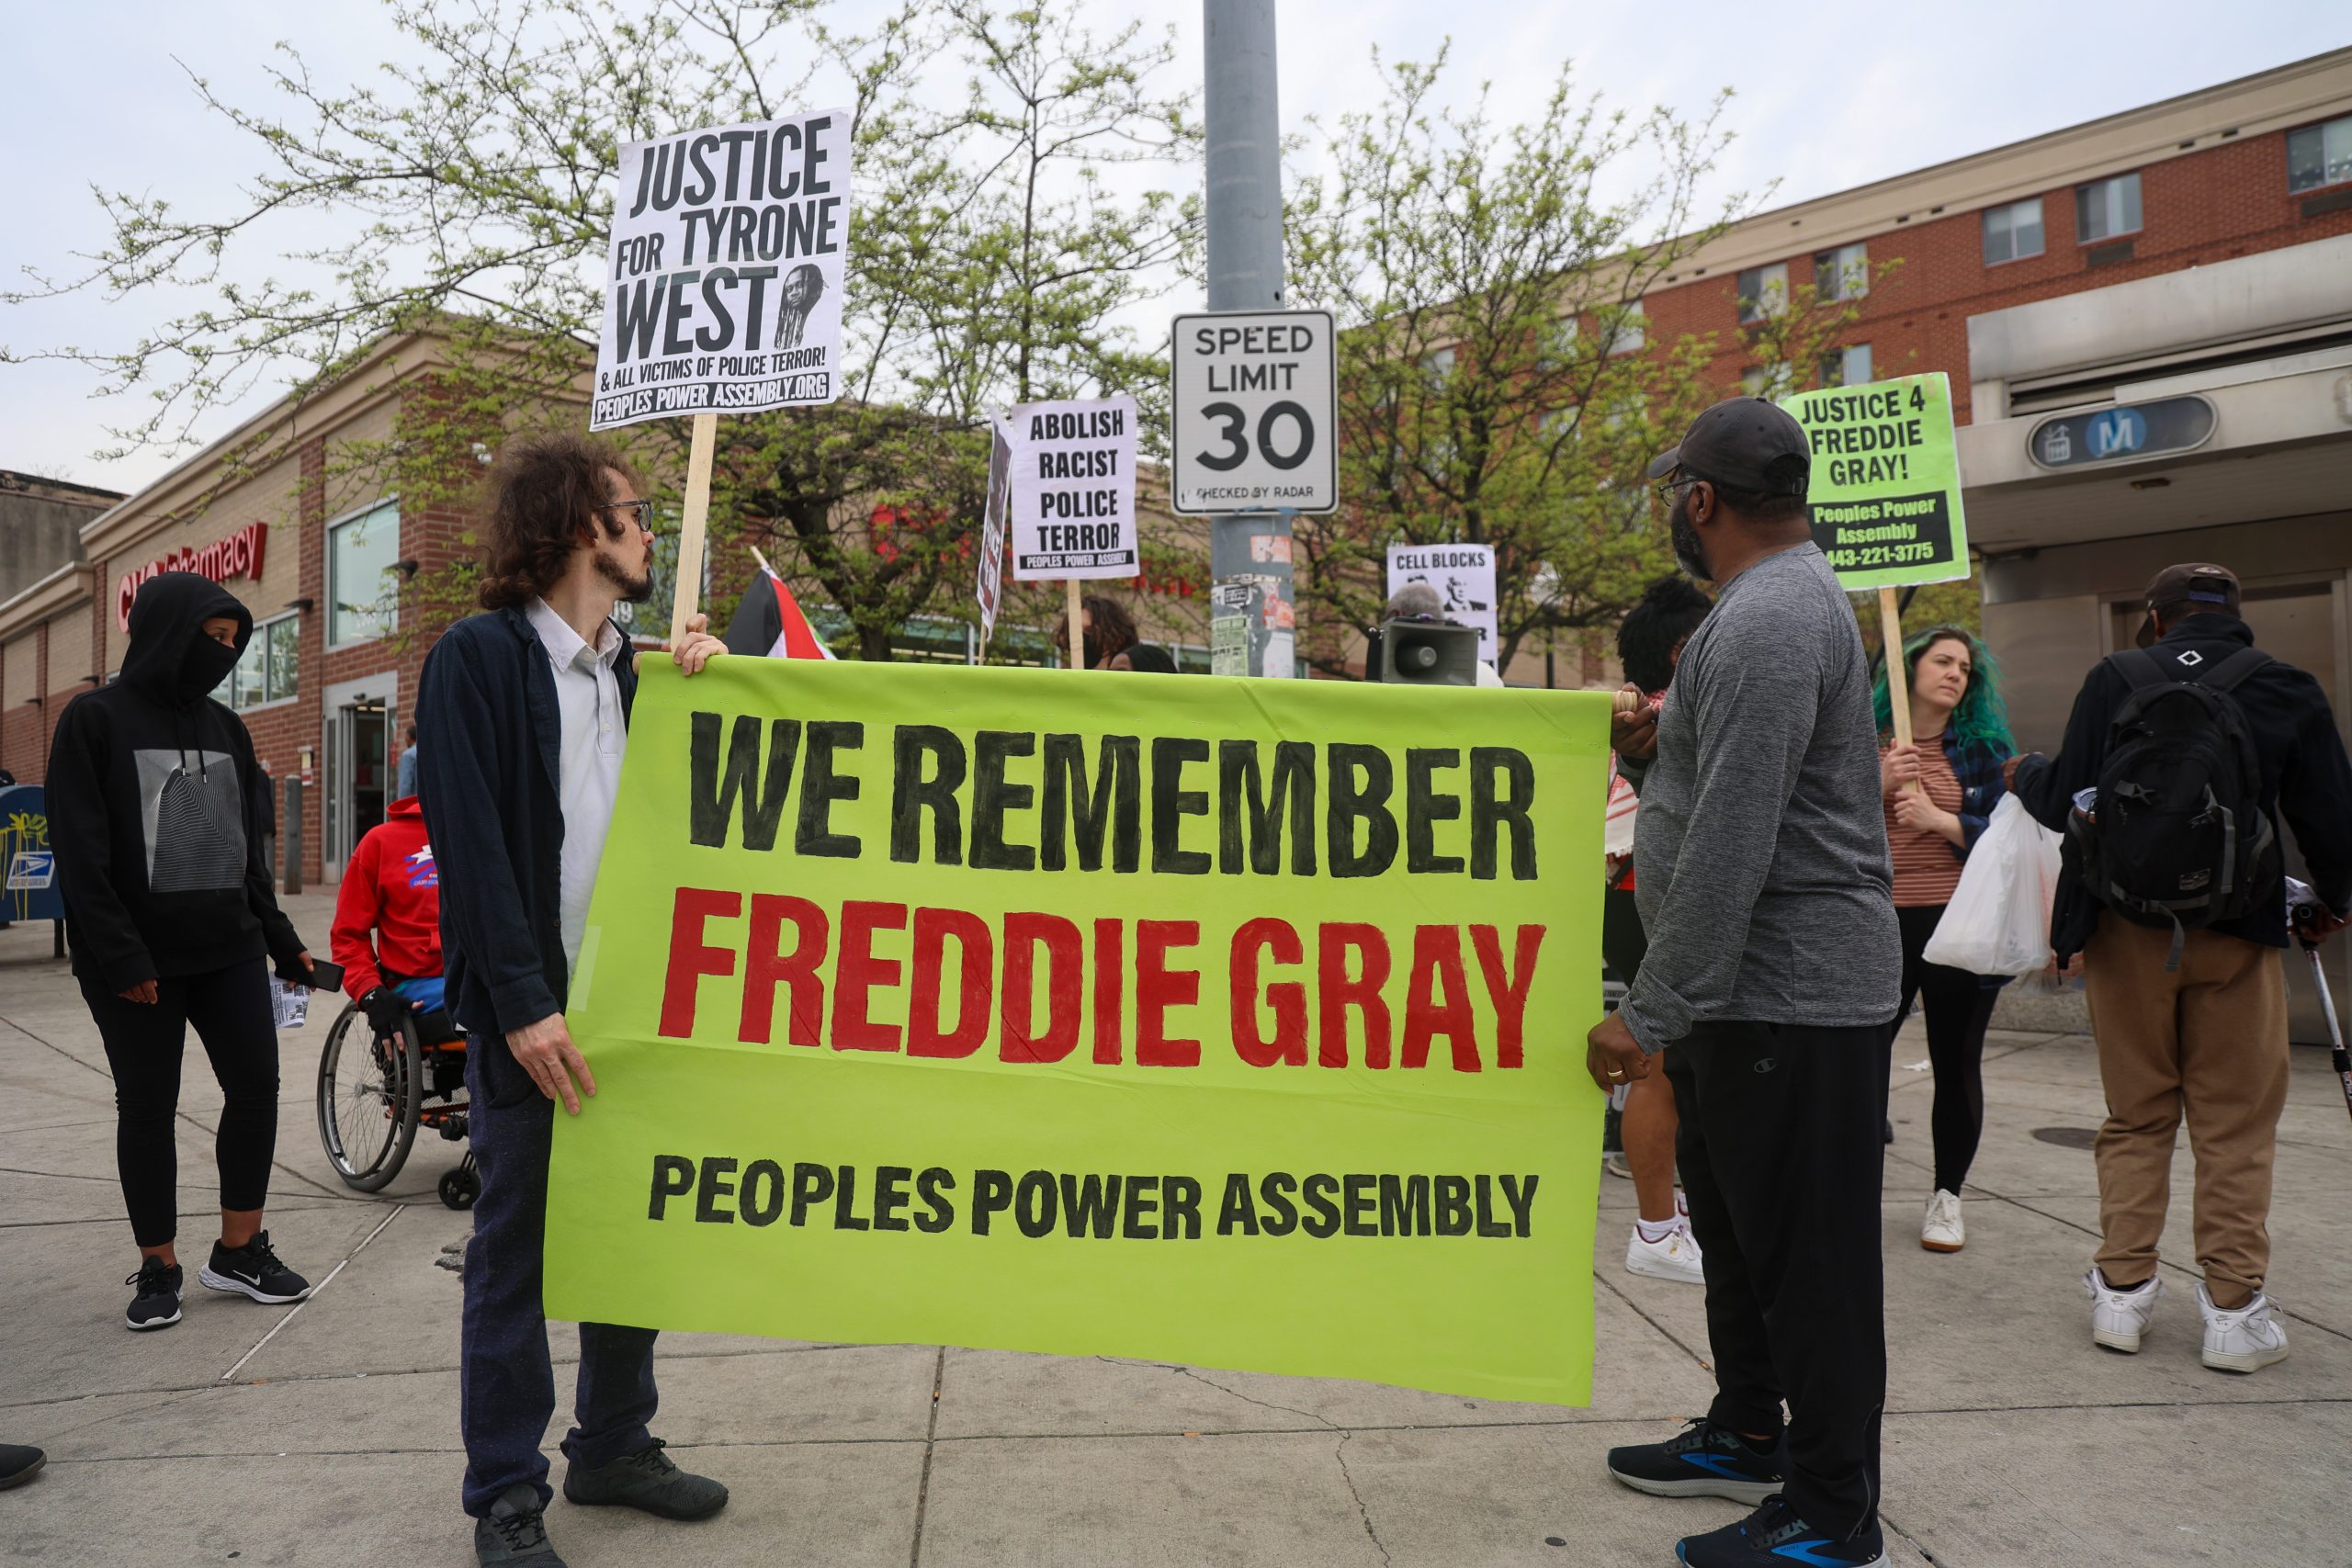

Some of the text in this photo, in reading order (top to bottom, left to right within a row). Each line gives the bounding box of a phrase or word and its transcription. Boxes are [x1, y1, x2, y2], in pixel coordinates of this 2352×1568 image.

[630, 116, 831, 219] JUSTICE
[616, 197, 841, 281] FOR TYRONE
[616, 265, 778, 364] WEST
[1194, 325, 1314, 355] SPEED
[600, 346, 827, 392] & ALL VICTIMS OF POLICE TERROR!
[1208, 363, 1299, 392] LIMIT
[596, 374, 827, 422] PEOPLES POWER ASSEMBLY.ORG
[1802, 384, 1925, 424] JUSTICE 4
[1030, 410, 1124, 441] ABOLISH
[1195, 400, 1315, 472] 30
[1811, 419, 1923, 455] FREDDIE
[1039, 449, 1118, 479] RACIST
[1830, 454, 1909, 486] GRAY!
[1041, 490, 1117, 518] POLICE
[1251, 487, 1269, 498] BY
[1274, 486, 1314, 498] RADAR
[1814, 498, 1937, 524] Peoples Power
[1037, 523, 1120, 552] TERROR
[1837, 523, 1917, 545] Assembly
[1027, 556, 1062, 568] PEOPLES
[1066, 554, 1094, 567] POWER
[1396, 552, 1486, 570] CELL BLOCKS
[1826, 542, 1934, 567] 443-221-3775
[689, 711, 1538, 881] WE REMEMBER
[657, 887, 1547, 1073] FREDDIE GRAY
[648, 1154, 1539, 1239] PEOPLES POWER ASSEMBLY
